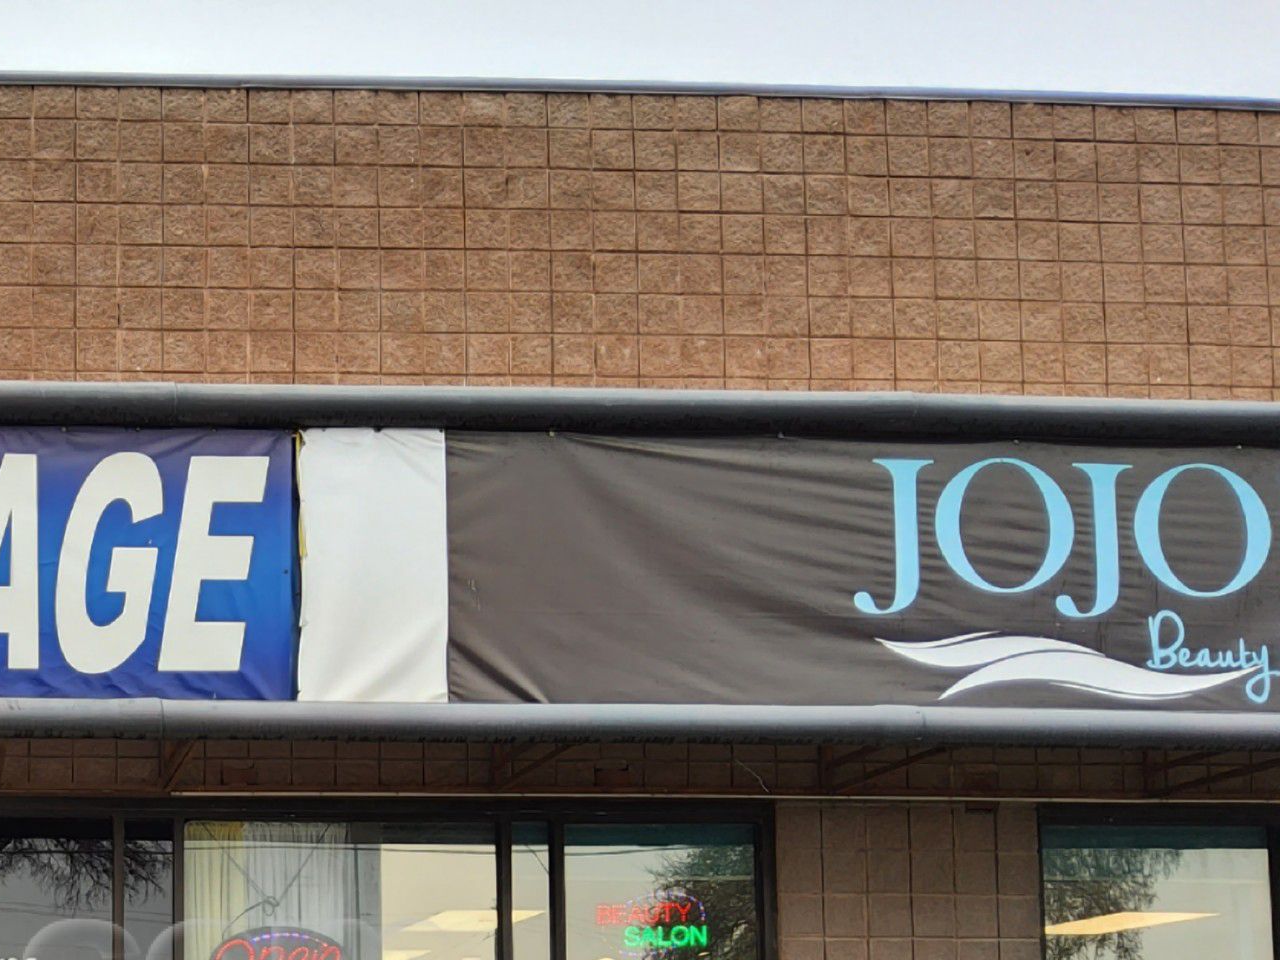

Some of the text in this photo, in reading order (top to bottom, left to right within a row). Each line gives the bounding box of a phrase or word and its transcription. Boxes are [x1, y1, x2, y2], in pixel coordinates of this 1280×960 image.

[853, 457, 1272, 618] JOJO
[1147, 609, 1280, 704] Beauty
[596, 902, 691, 925] BEAUTY
[624, 925, 707, 948] SALON
